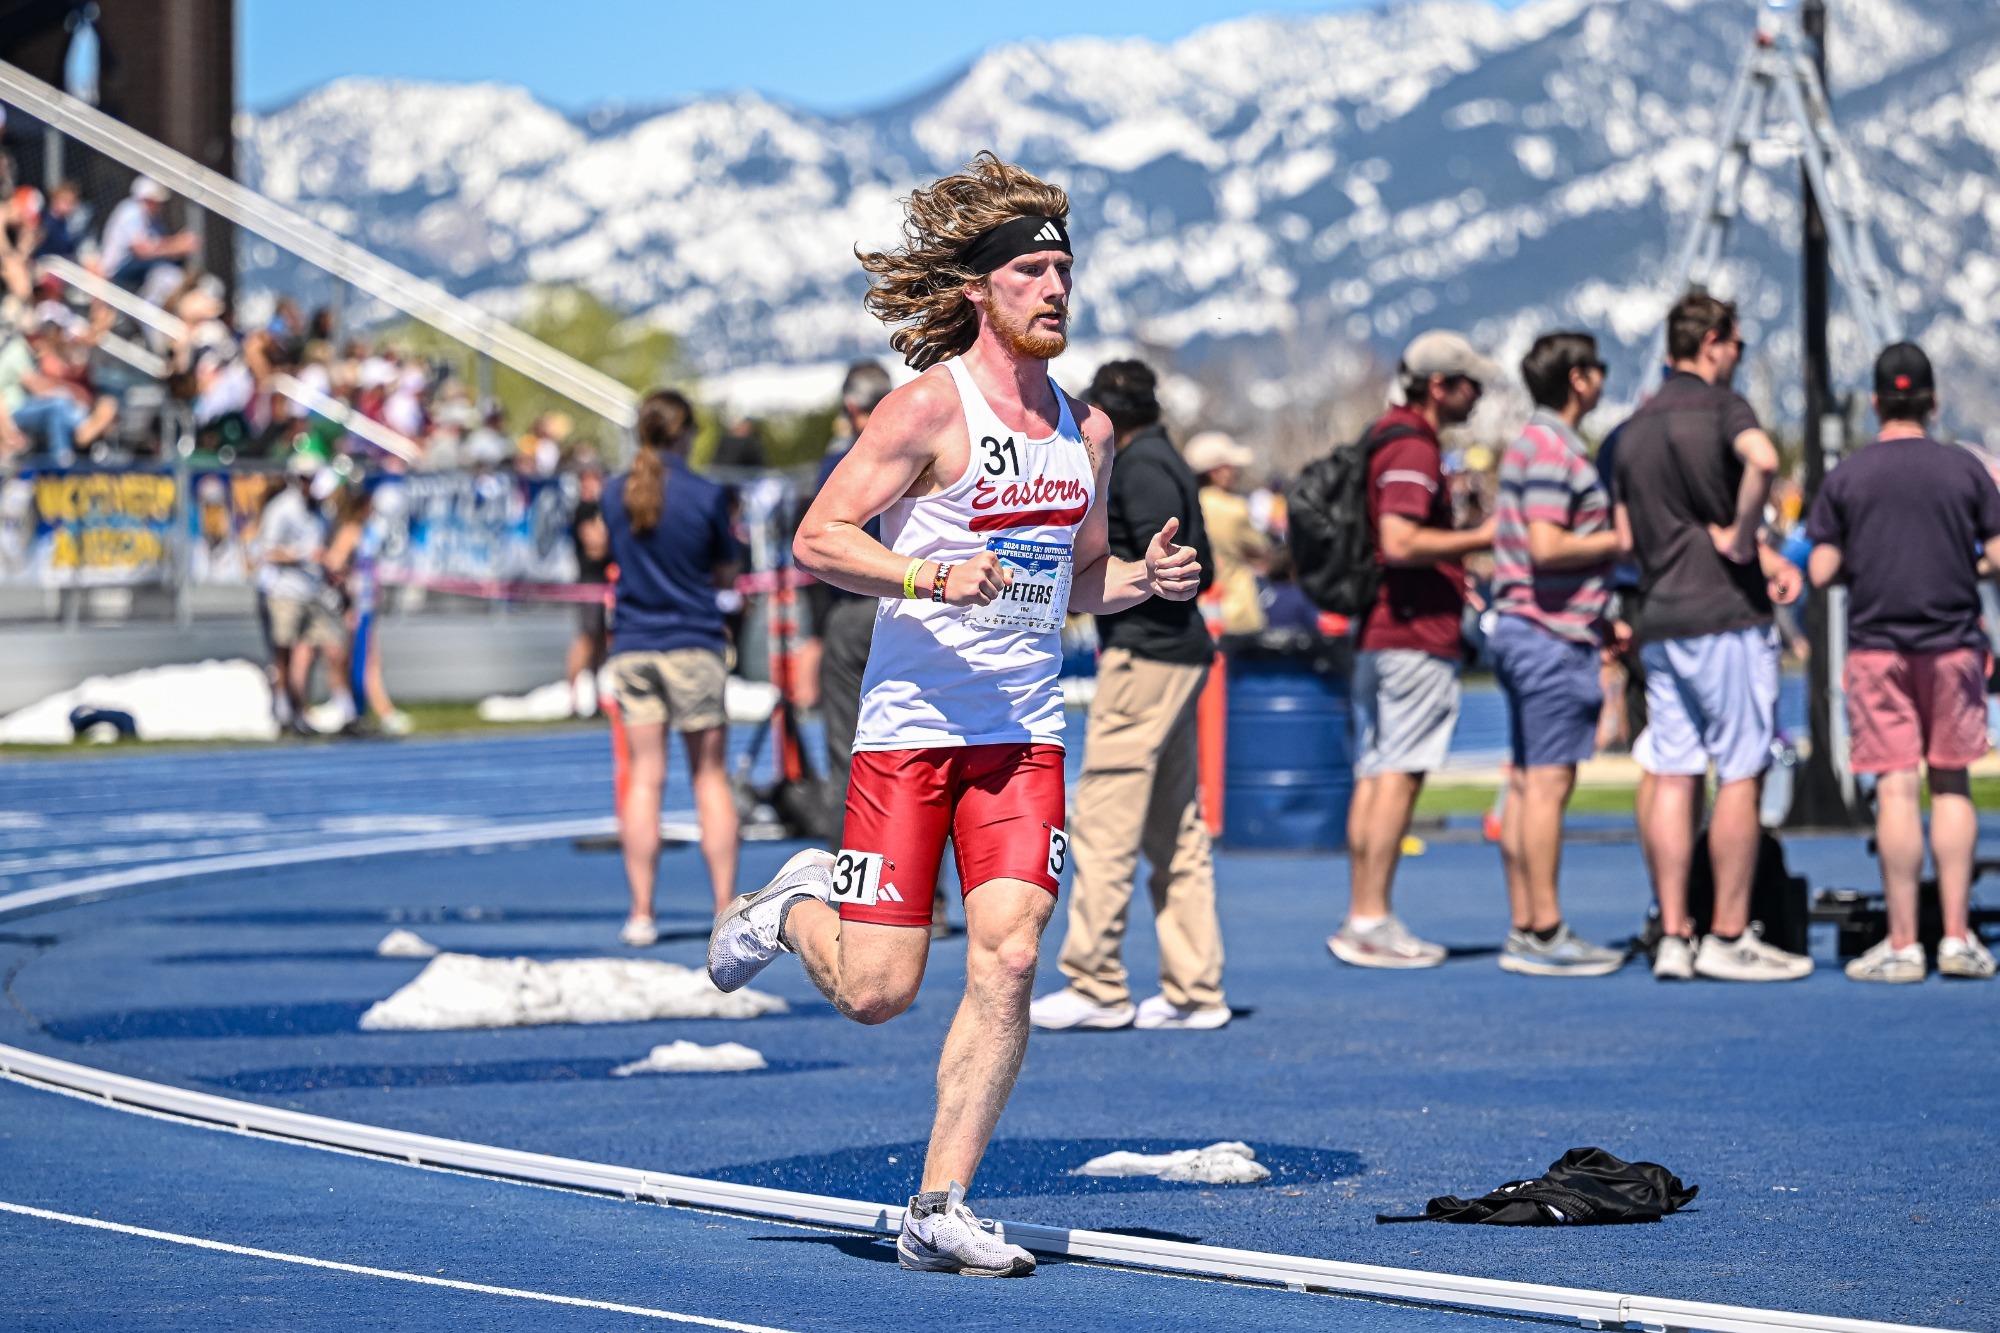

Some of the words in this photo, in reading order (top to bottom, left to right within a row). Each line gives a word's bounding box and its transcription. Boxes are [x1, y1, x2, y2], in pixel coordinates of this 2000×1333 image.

[980, 435, 1020, 477] 31
[971, 473, 1087, 511] Eastern
[994, 548, 1034, 559] CONFERENCE
[1003, 541, 1019, 550] 2024
[1032, 545, 1044, 553] SKY
[1001, 582, 1054, 605] PETERS
[832, 854, 868, 899] 31
